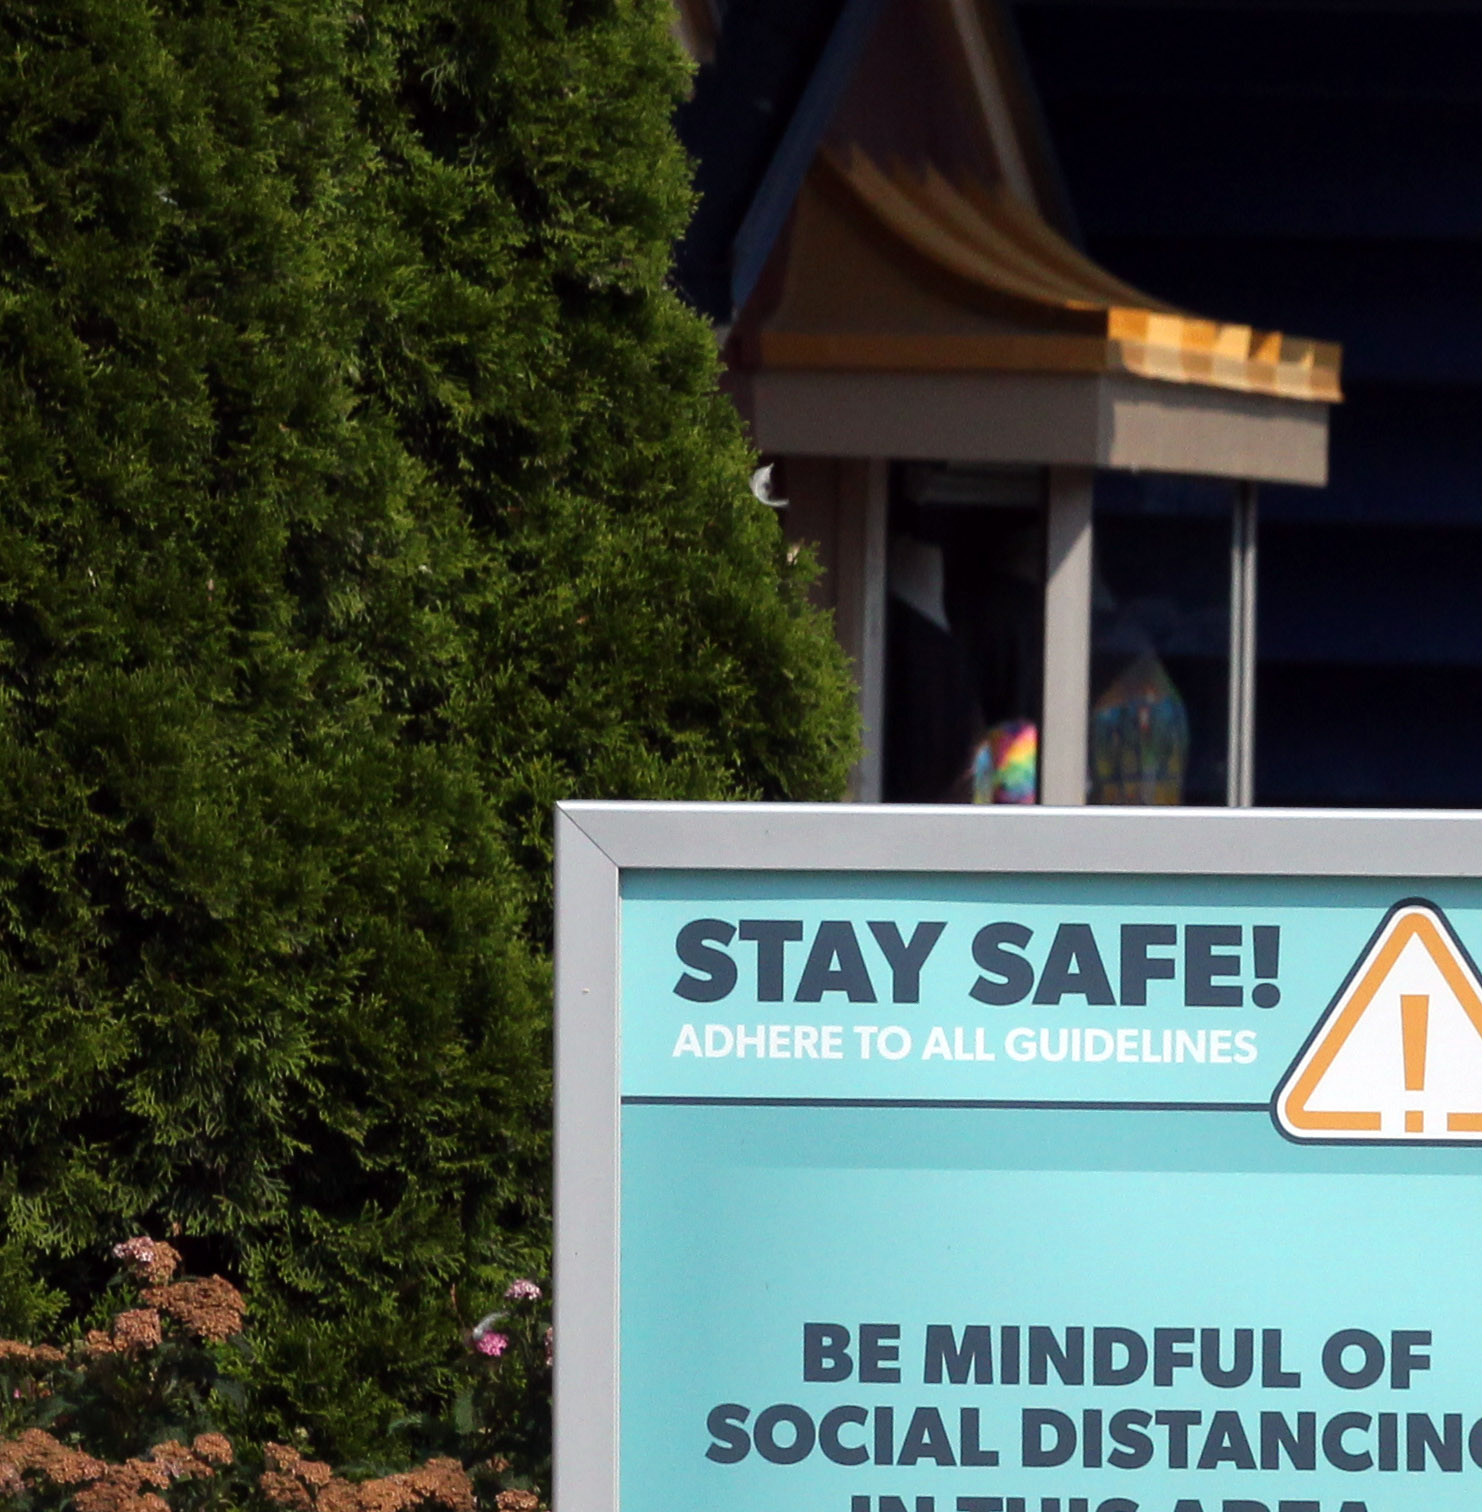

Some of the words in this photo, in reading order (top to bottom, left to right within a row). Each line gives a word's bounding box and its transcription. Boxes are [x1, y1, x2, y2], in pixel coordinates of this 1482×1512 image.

[673, 918, 947, 1004] STAY
[969, 921, 1281, 1009] SAFE!
[672, 1023, 844, 1060] ADHERE
[853, 1025, 913, 1061] TO
[921, 1026, 996, 1062] ALL
[1004, 1026, 1259, 1065] GUIDELINES
[803, 1322, 901, 1384] BE
[923, 1324, 1301, 1389] MINDFUL
[1321, 1328, 1432, 1390] OF
[704, 1402, 1000, 1467] SOCIAL
